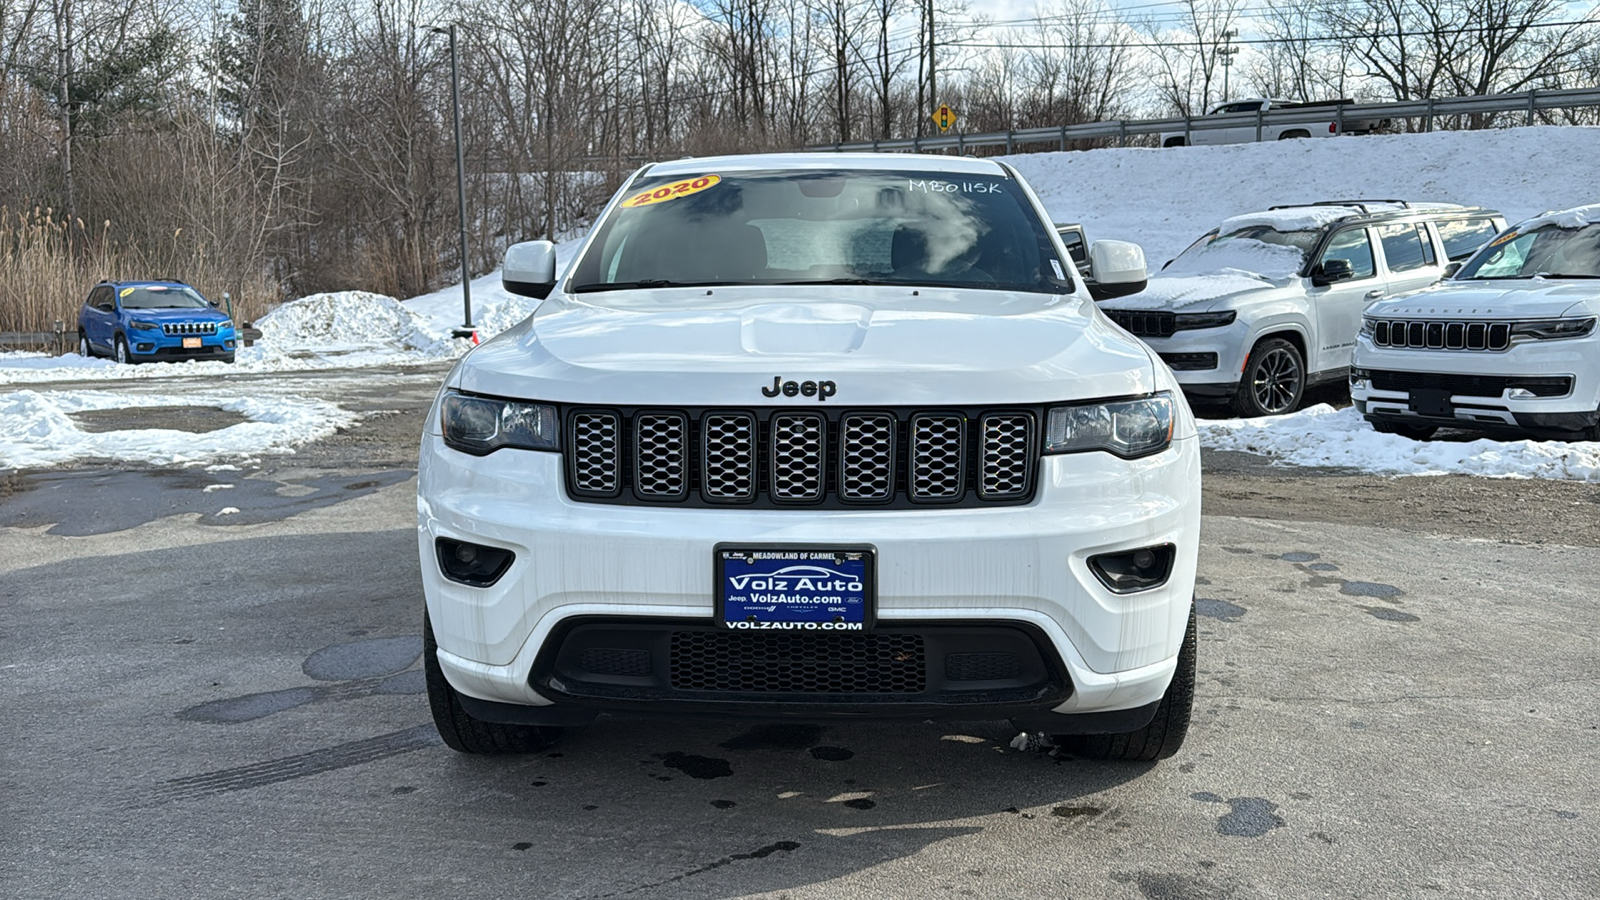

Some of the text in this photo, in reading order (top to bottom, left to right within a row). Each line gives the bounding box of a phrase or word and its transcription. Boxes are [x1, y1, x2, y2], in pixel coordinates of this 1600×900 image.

[633, 178, 709, 206] 2020
[761, 376, 837, 402] Jeep
[752, 552, 798, 560] MEADOWLAND
[729, 577, 863, 591] Volz Auto
[750, 593, 842, 604] VolzAuto.com
[726, 621, 863, 630] VOLZAUTO.COM
